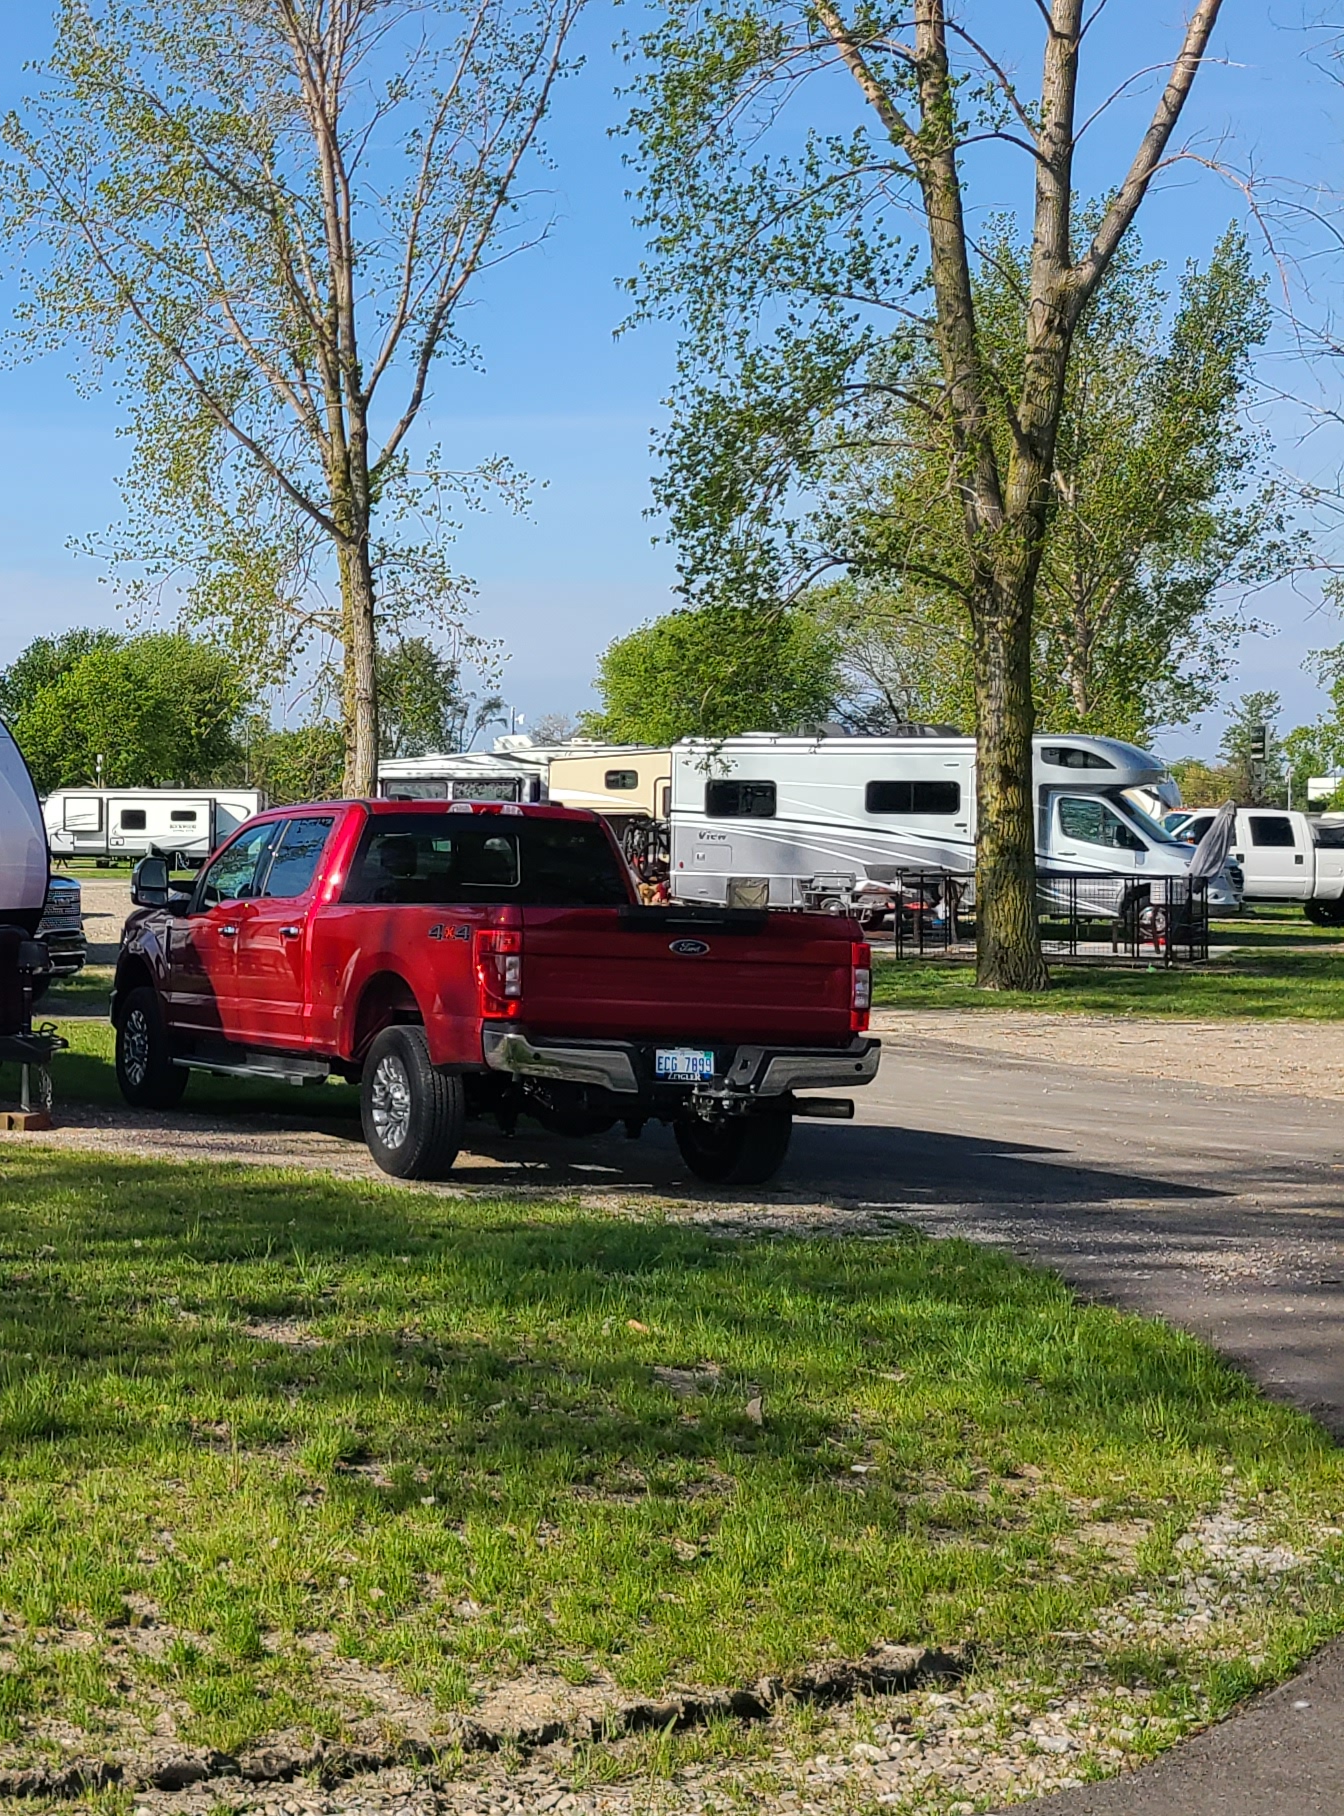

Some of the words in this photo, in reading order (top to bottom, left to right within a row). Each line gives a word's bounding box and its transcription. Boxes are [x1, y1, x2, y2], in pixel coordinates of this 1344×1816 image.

[679, 942, 701, 952] Ford
[657, 1056, 678, 1071] ECG
[684, 1057, 712, 1073] 7899
